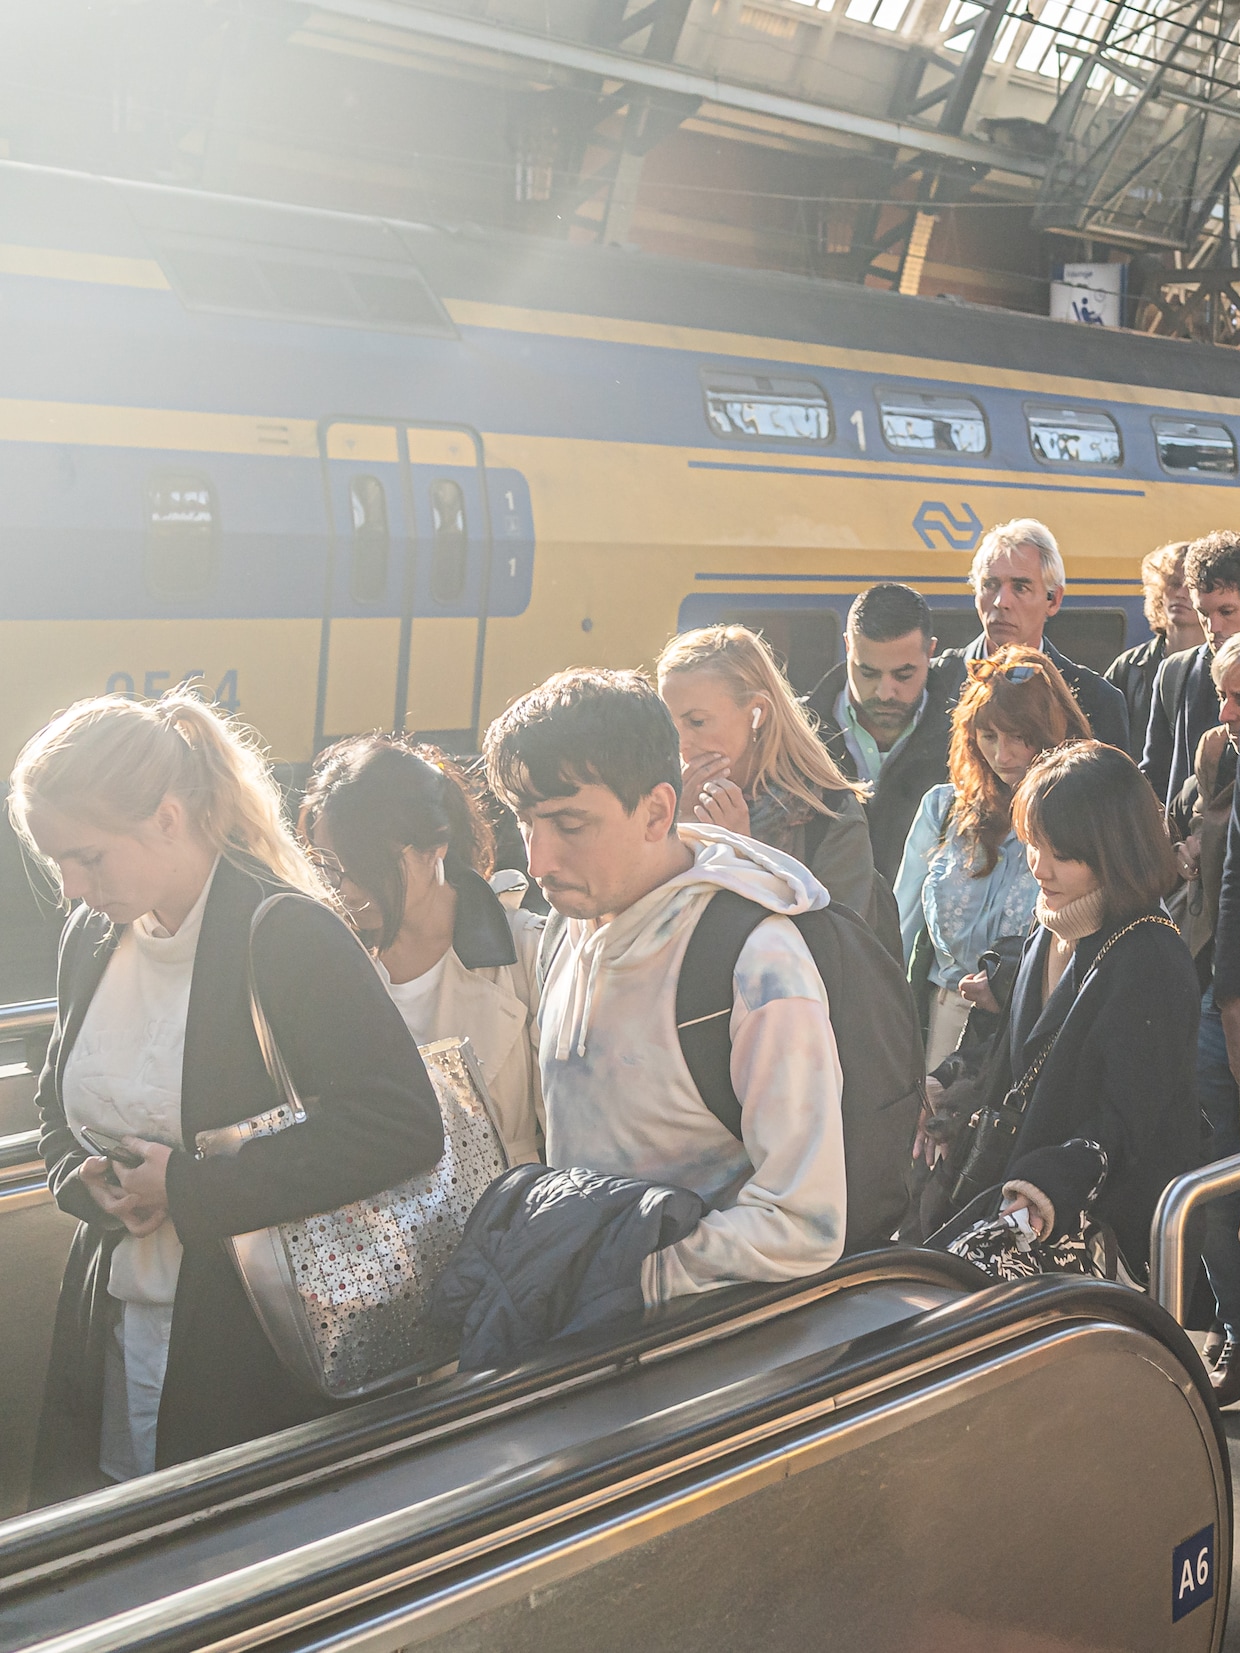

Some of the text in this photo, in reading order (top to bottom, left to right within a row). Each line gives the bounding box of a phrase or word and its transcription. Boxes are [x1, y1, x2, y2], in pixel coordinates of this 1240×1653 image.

[850, 410, 866, 451] 1
[505, 490, 514, 510] 1
[508, 557, 516, 576] 1
[1178, 1546, 1209, 1600] A6
